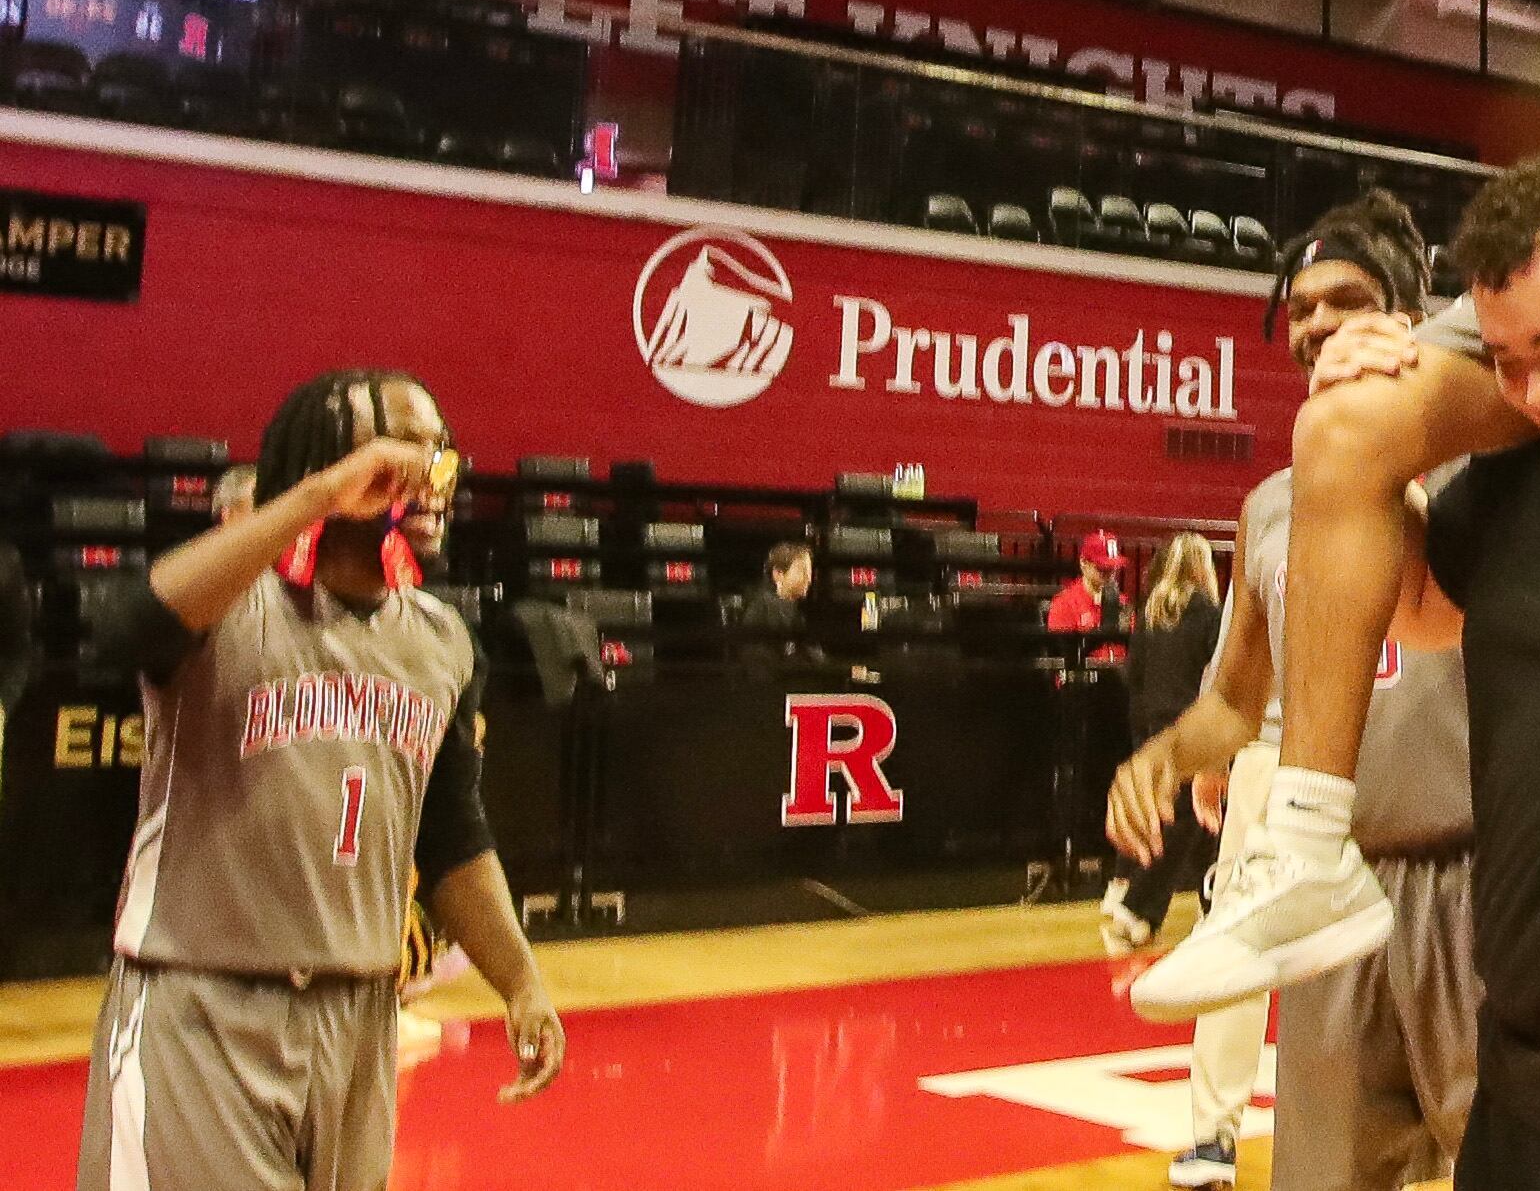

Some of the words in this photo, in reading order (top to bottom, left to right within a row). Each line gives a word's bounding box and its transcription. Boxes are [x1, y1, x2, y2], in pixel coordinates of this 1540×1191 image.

[0, 215, 130, 261] MPER
[829, 294, 1239, 420] Prudential
[333, 766, 366, 867] 1
[781, 693, 903, 828] R
